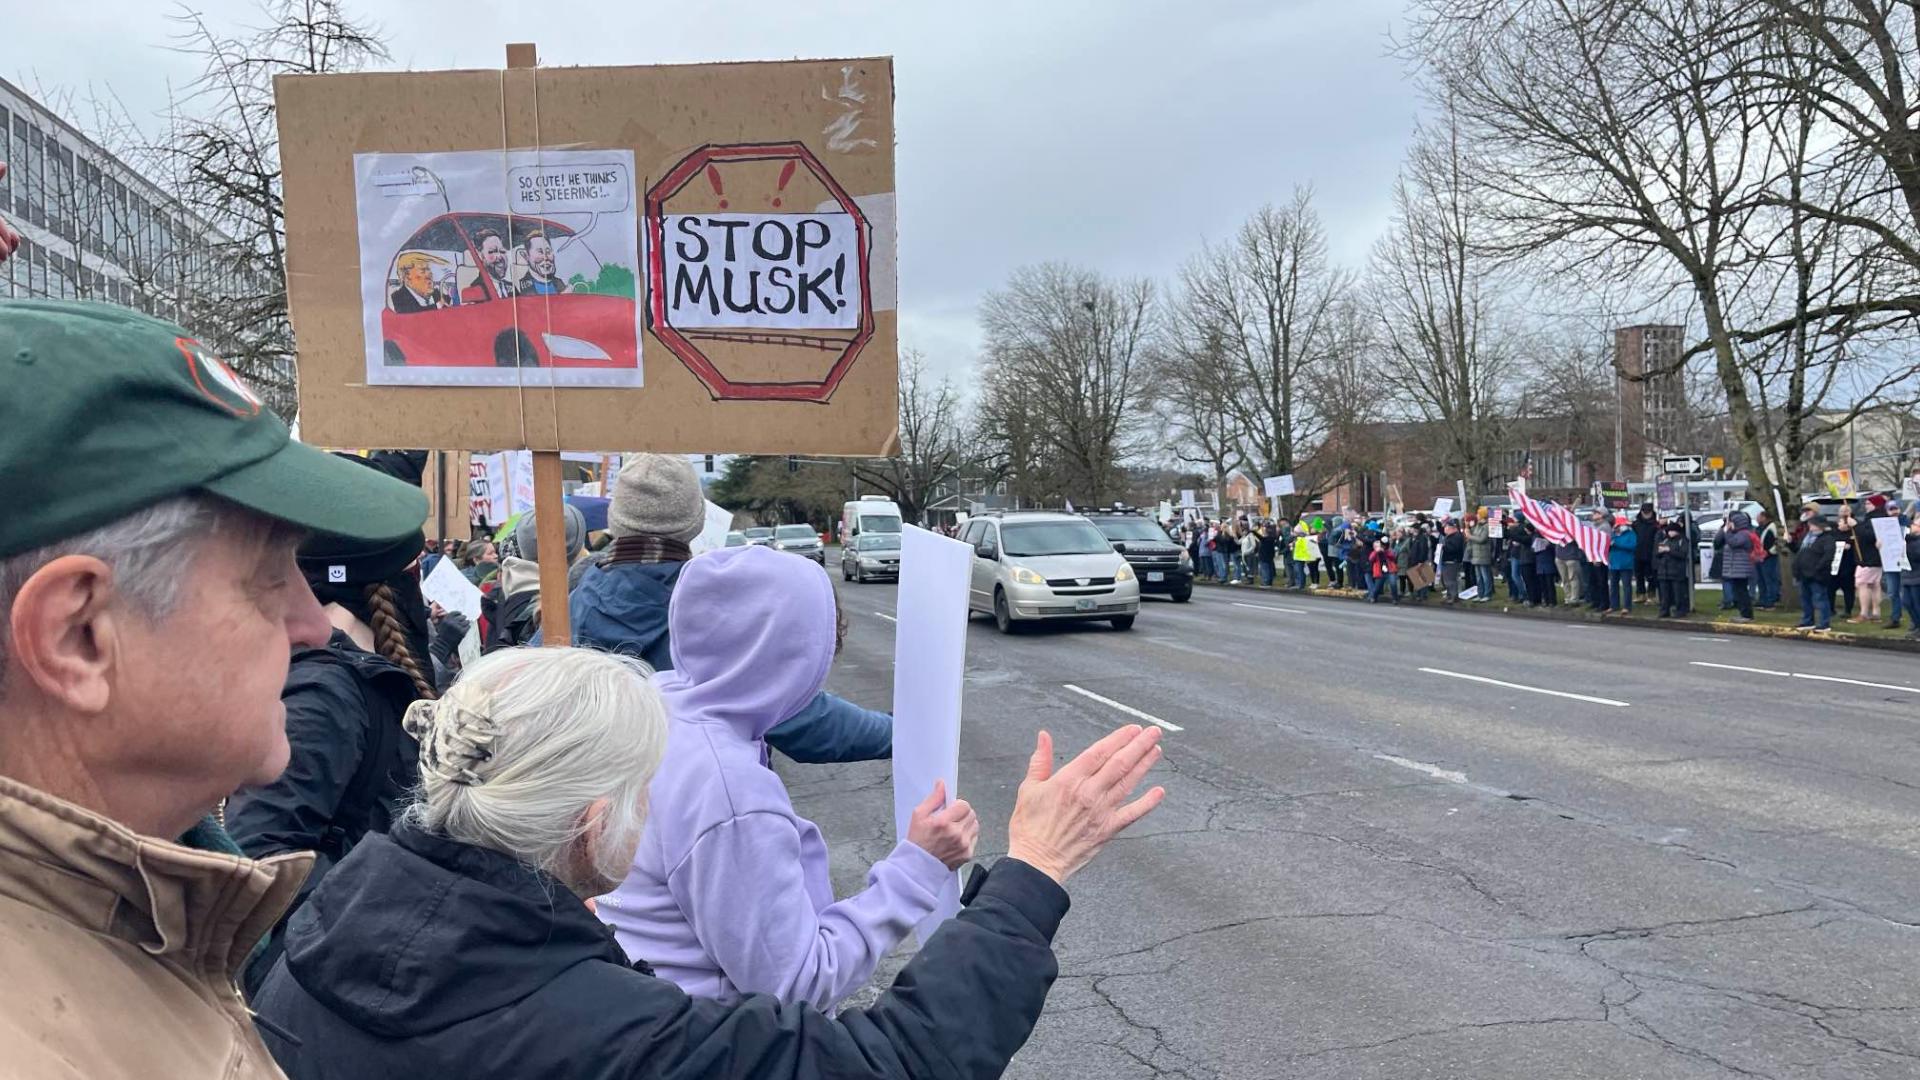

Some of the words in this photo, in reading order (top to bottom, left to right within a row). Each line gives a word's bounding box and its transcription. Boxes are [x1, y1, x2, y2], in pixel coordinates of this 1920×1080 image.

[518, 176, 533, 189] SO
[535, 173, 565, 188] CUTE!
[568, 173, 580, 185] HE
[583, 171, 618, 185] THINKS
[675, 216, 831, 266] STOP
[672, 253, 847, 316] MUSK!
